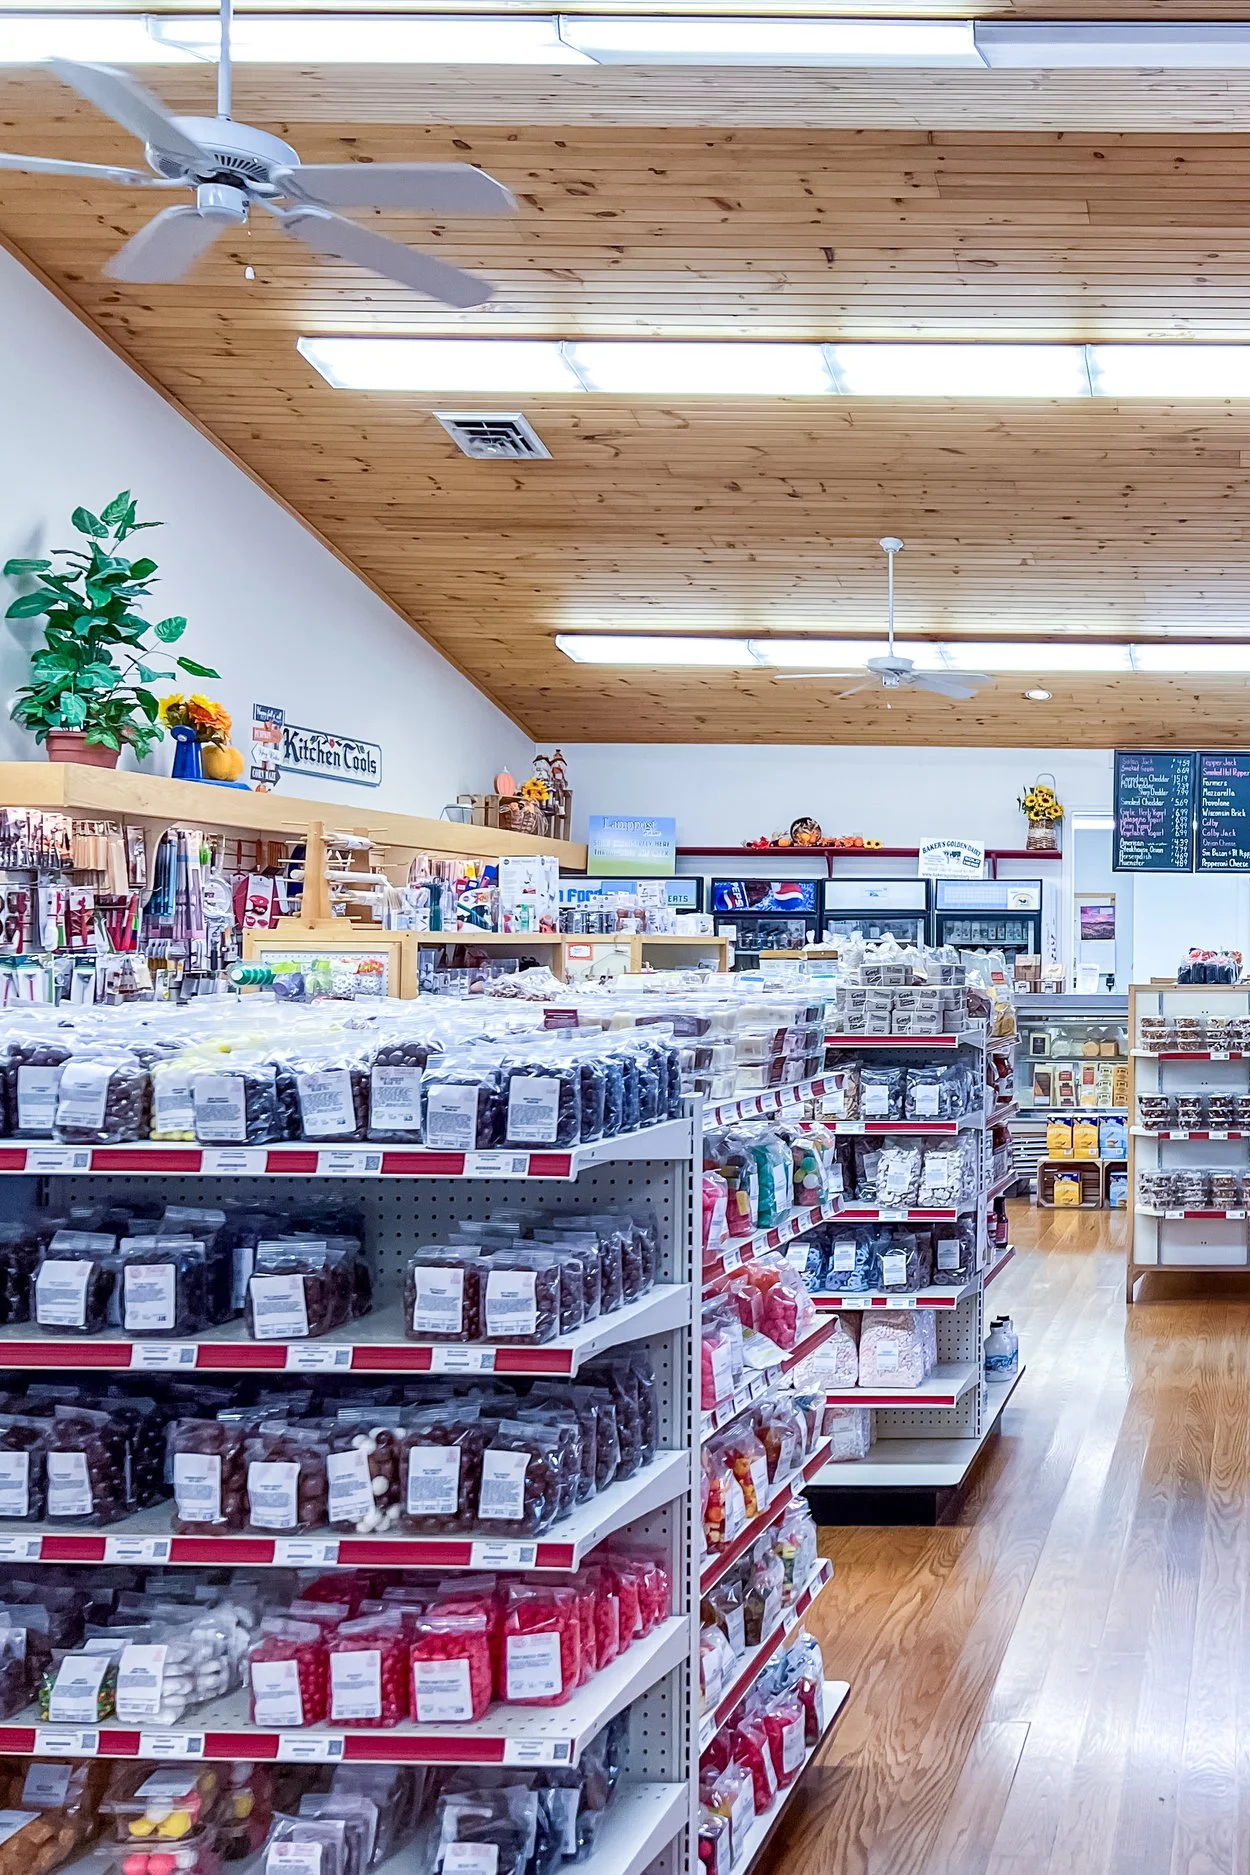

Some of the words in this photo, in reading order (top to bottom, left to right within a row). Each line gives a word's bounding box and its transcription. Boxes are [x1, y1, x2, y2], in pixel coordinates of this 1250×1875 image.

[283, 728, 341, 767] Kitchen
[342, 742, 377, 774] Tools
[731, 882, 745, 909] PEPSI
